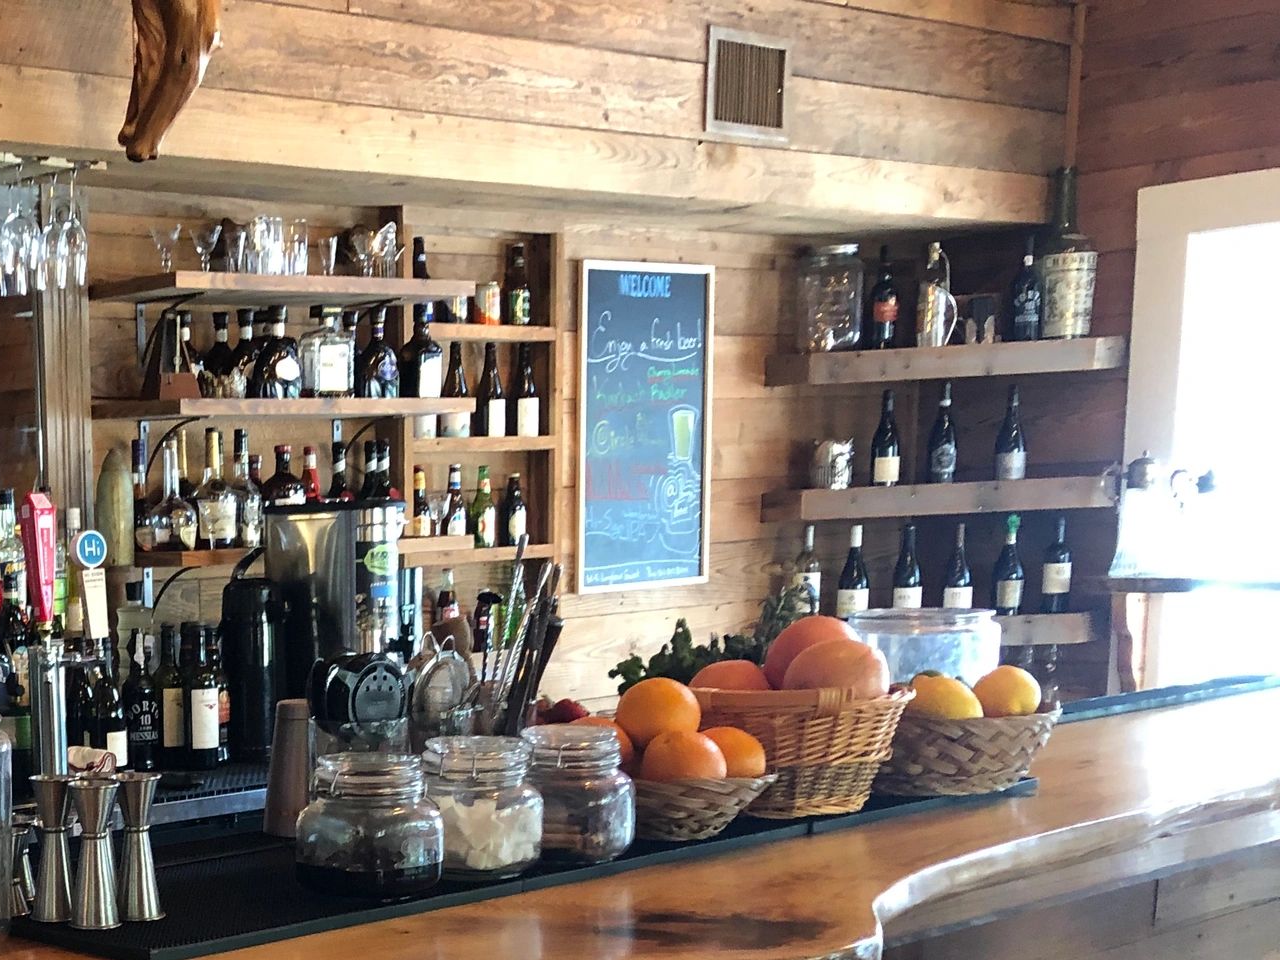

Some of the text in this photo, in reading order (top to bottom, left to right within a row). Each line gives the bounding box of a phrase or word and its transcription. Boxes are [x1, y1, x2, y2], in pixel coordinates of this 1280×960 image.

[618, 273, 672, 298] WELCOME
[590, 310, 633, 373] Enjoy
[84, 539, 101, 557] Hi
[140, 713, 152, 725] 10
